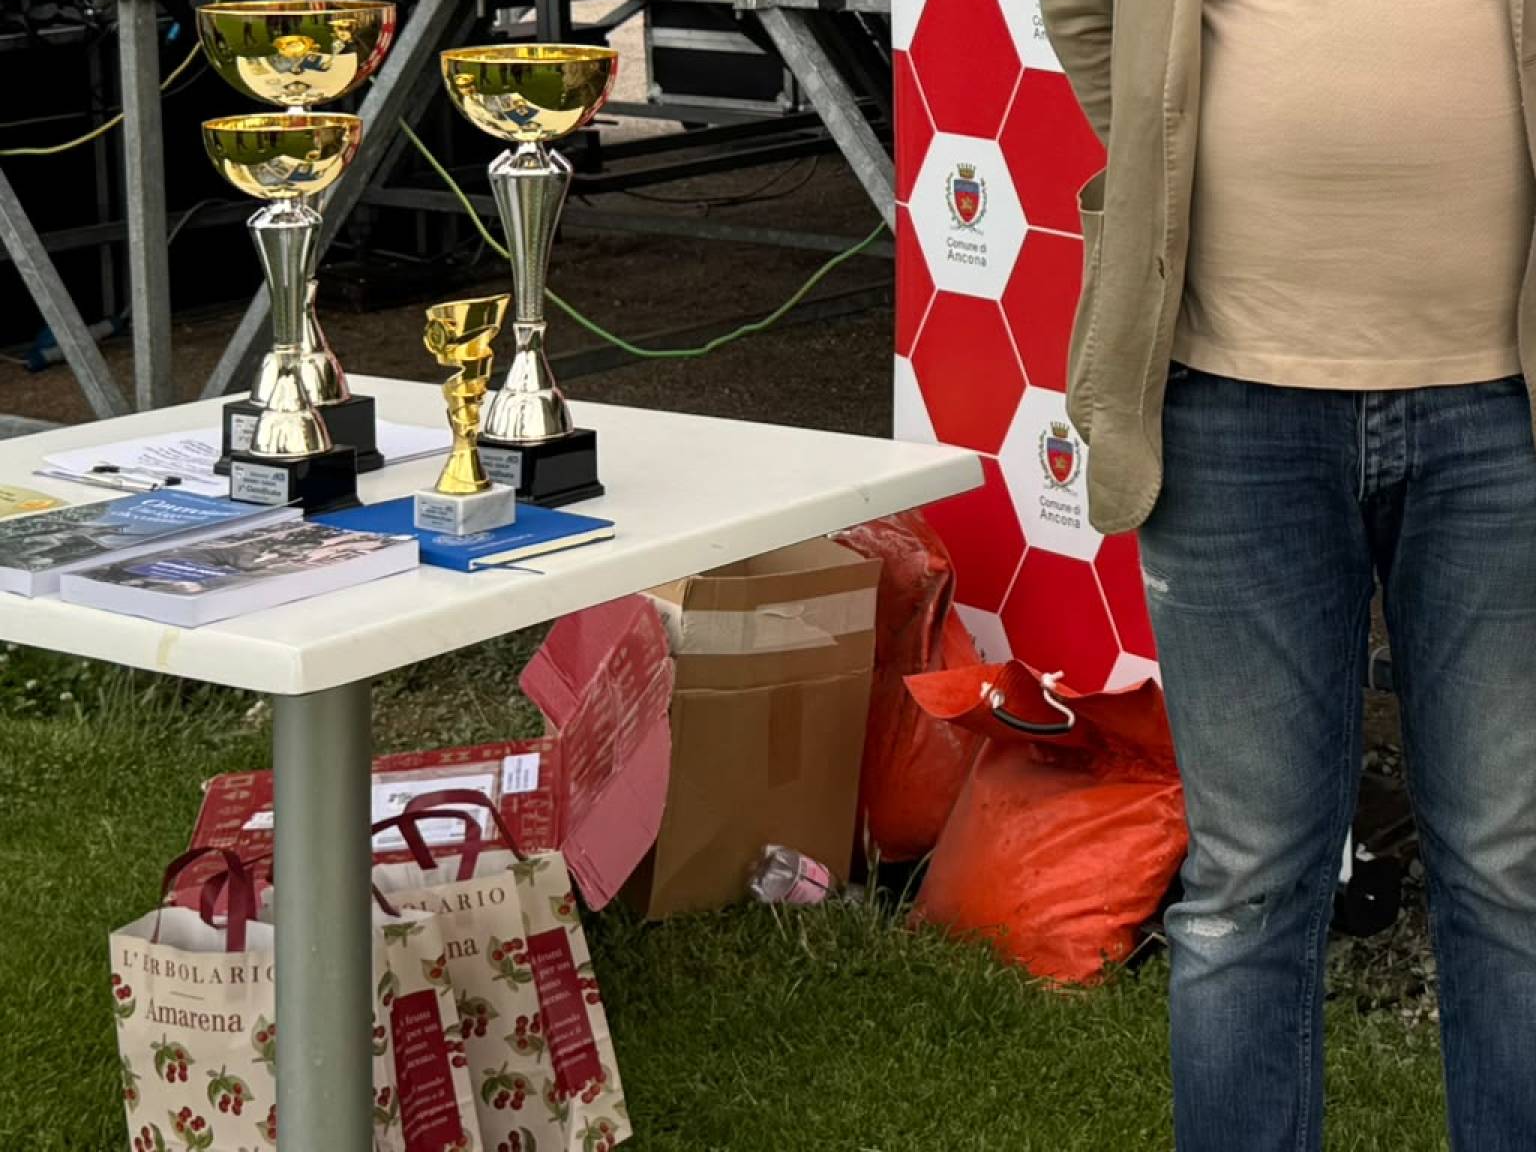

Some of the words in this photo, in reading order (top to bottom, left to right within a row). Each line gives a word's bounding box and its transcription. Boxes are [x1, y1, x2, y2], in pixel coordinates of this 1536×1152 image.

[945, 236, 978, 251] Comune
[980, 242, 988, 254] di
[947, 249, 987, 267] Ancona
[1039, 494, 1071, 513] Comune
[1073, 504, 1081, 516] di
[1040, 507, 1081, 529] Ancona
[145, 998, 245, 1033] Amarena
